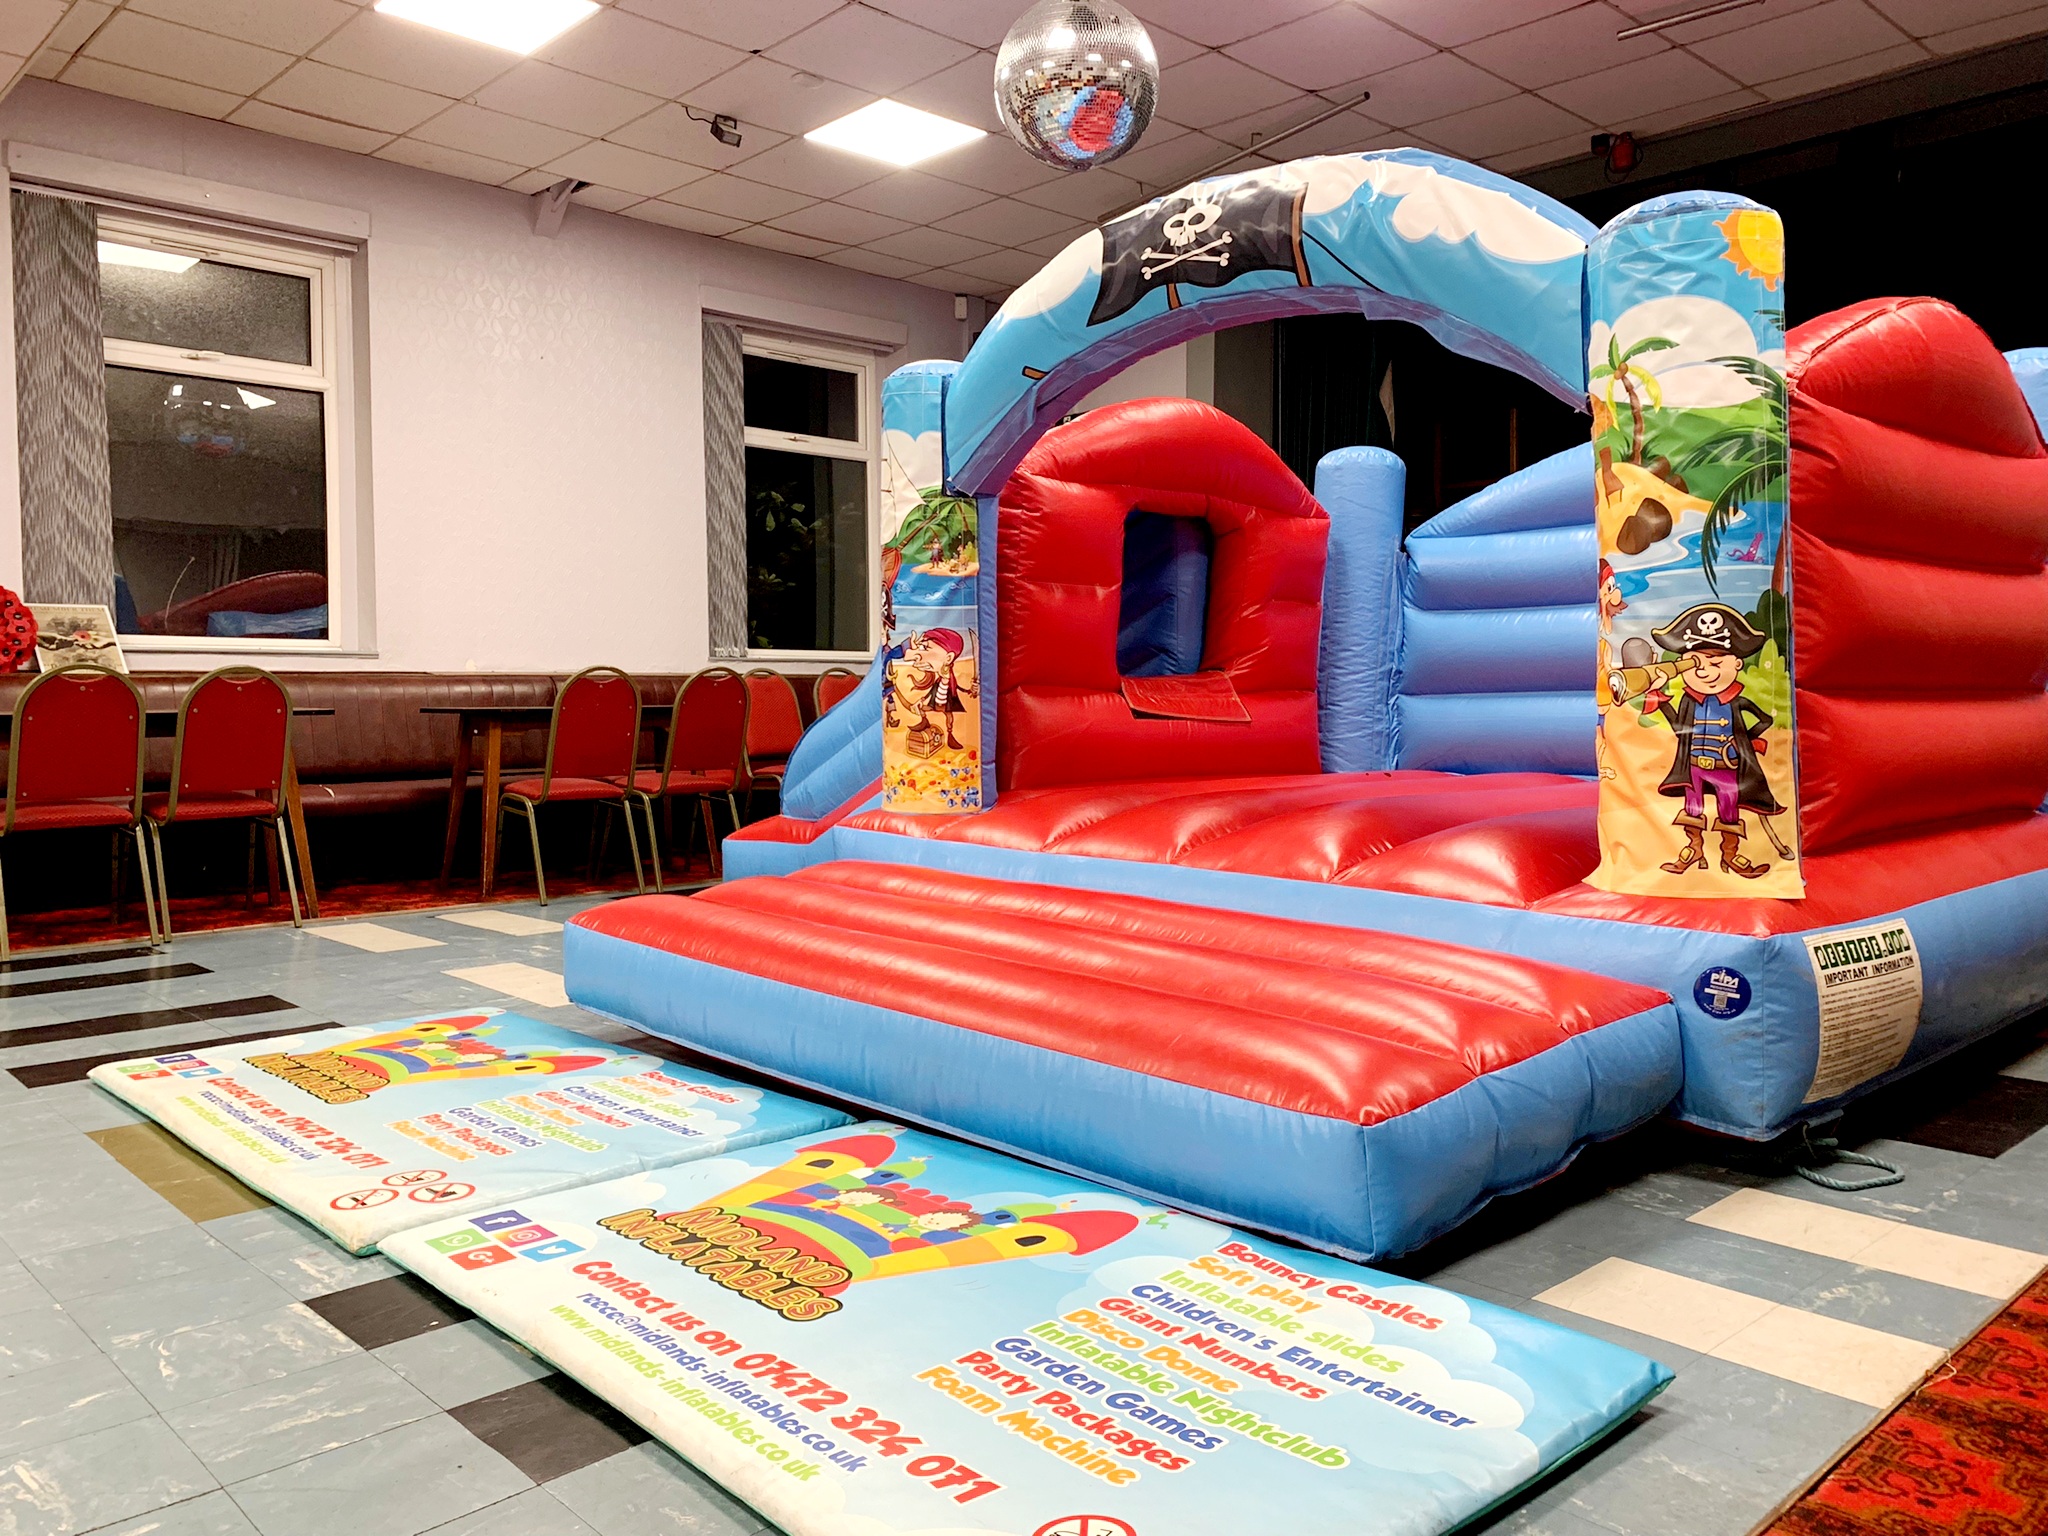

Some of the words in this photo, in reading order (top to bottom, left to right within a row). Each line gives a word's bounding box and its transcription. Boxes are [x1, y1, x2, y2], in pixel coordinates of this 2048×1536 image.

[1824, 966, 1868, 985] IMPORTANT
[1871, 955, 1914, 975] INFORMATION
[260, 1108, 288, 1118] on
[418, 1113, 455, 1131] Party
[449, 1128, 513, 1156] Packages
[448, 1107, 499, 1130] Garden
[492, 1126, 542, 1148] Games
[574, 1105, 633, 1128] Numbers
[623, 1108, 703, 1137] Entertainer
[641, 1071, 692, 1088] Bouncy
[687, 1086, 741, 1104] Castles
[596, 1208, 844, 1322] INFLATABLES
[666, 1206, 853, 1288] MIDLAND
[1188, 1256, 1256, 1286] Soft
[1248, 1283, 1322, 1313] play
[1217, 1242, 1326, 1290] Bouncy
[1326, 1285, 1446, 1330] Castles
[1064, 1309, 1145, 1349] Disco
[1144, 1346, 1239, 1392] Dome
[1099, 1297, 1186, 1337] Giant
[1181, 1332, 1327, 1399] Numbers
[1131, 1284, 1278, 1351] Children's
[1275, 1346, 1477, 1428] Entertainer
[1160, 1270, 1304, 1334] Inflatable
[1304, 1331, 1405, 1374] slides
[549, 1304, 821, 1481] www.midlands-inflatables.co.uk
[572, 1261, 678, 1314] Contact
[660, 1311, 706, 1332] us
[694, 1330, 742, 1356] on
[733, 1353, 849, 1413] 07472
[831, 1407, 924, 1457] 324
[906, 1455, 1002, 1504] 071
[576, 1292, 868, 1472] reece@midlands-inflatables.co.uk
[916, 1365, 1002, 1414] Foam
[997, 1409, 1136, 1485] Machine
[956, 1351, 1039, 1396] Party
[1033, 1390, 1191, 1470] Packages
[995, 1338, 1106, 1395] Garden
[1105, 1392, 1223, 1450] Games
[1028, 1322, 1178, 1394] Inflatable
[1172, 1390, 1345, 1467] Nightclub
